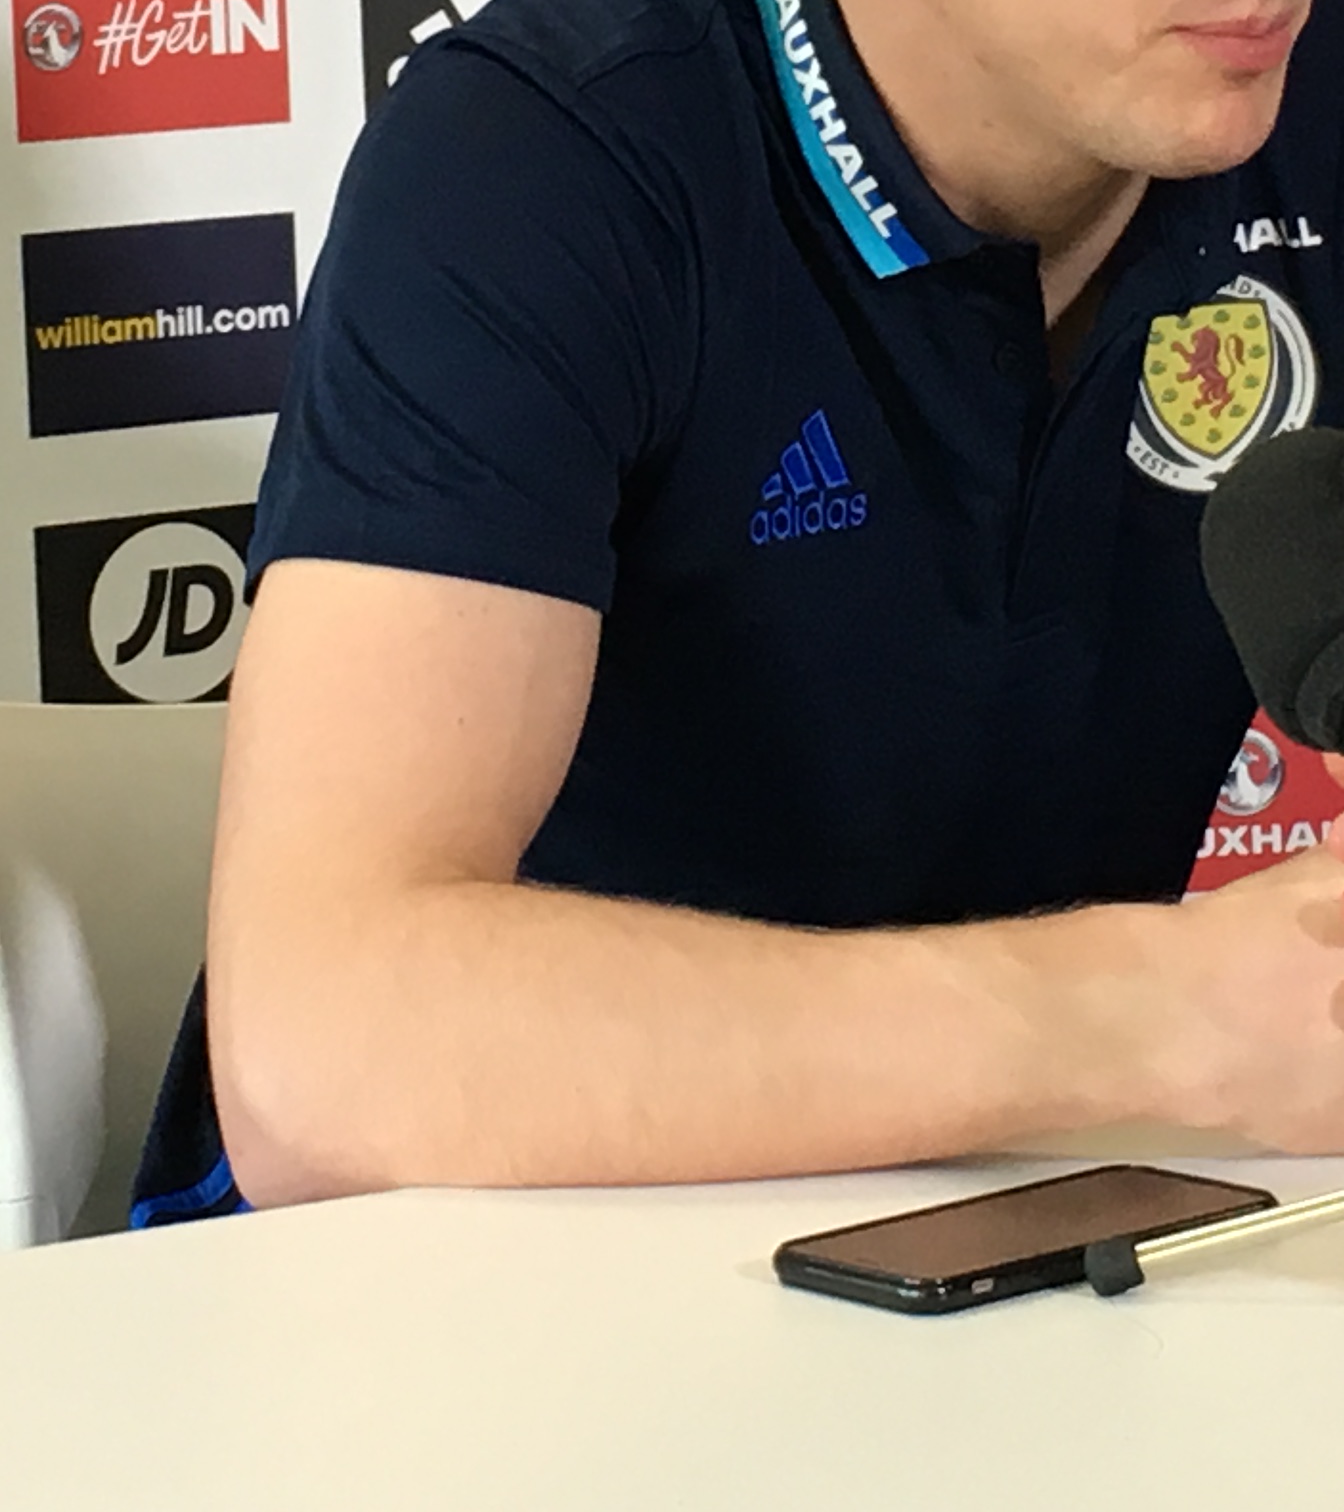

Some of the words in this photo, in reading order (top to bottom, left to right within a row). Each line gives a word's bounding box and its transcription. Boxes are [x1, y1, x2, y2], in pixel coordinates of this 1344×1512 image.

[35, 301, 290, 350] williamhill.com
[750, 490, 867, 544] adidas
[115, 563, 234, 667] JD
